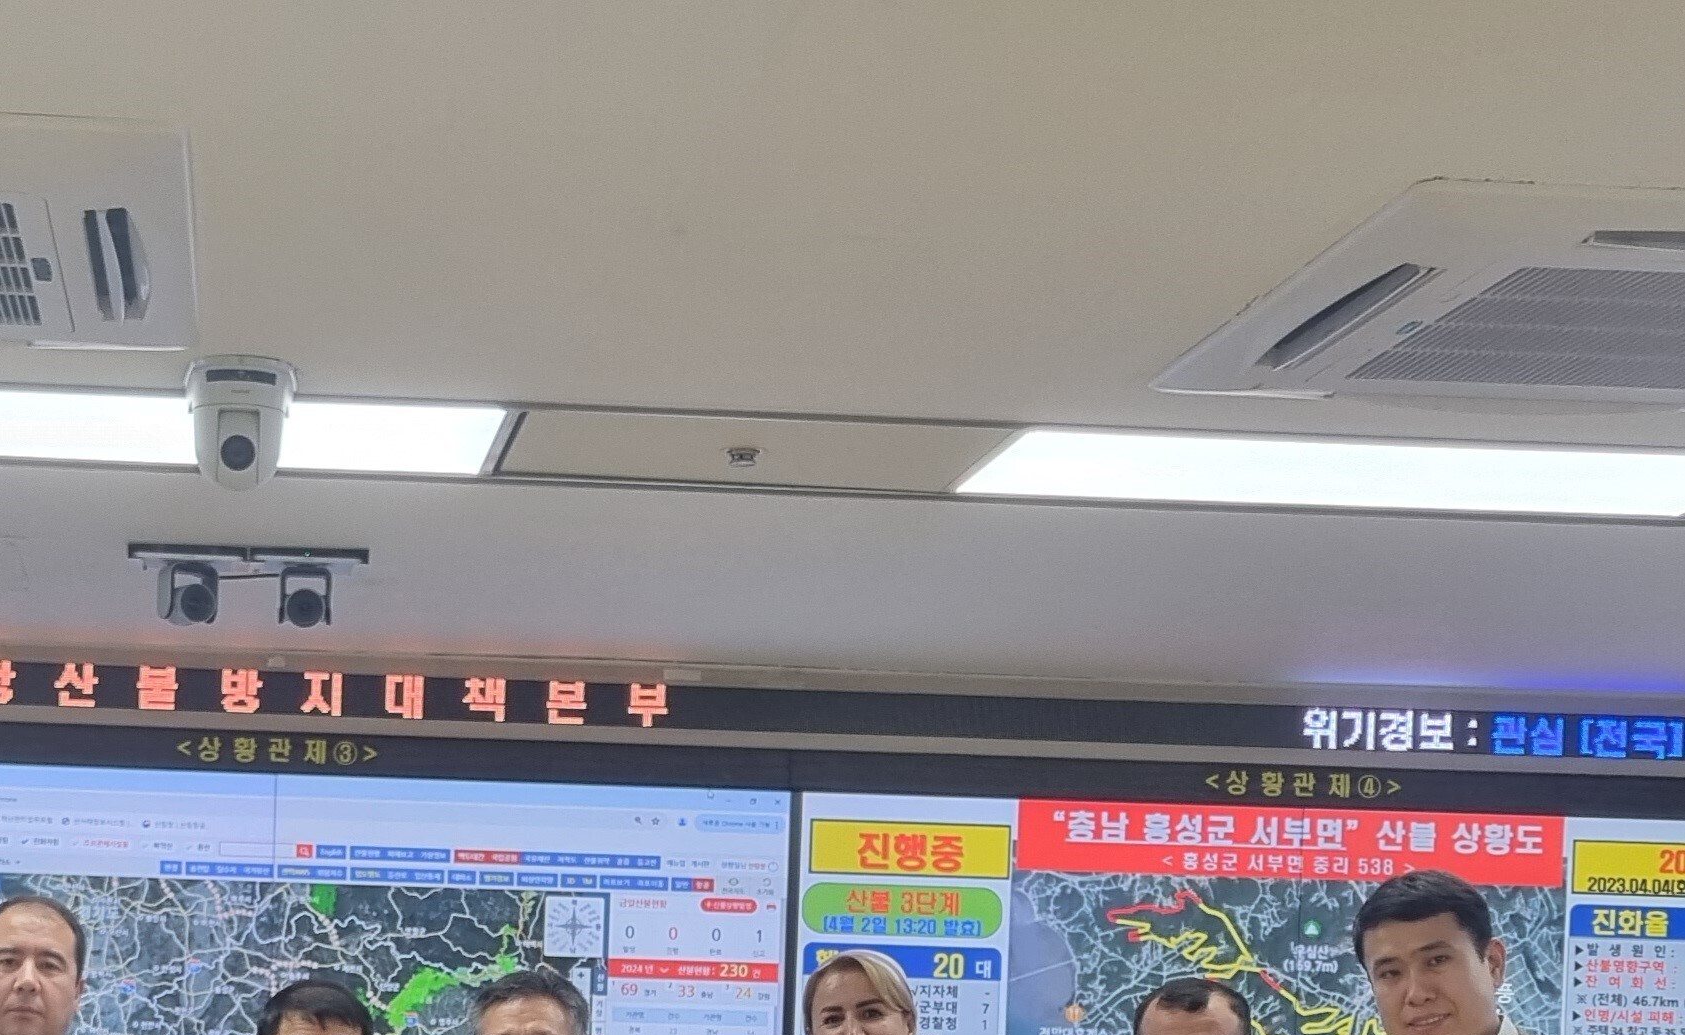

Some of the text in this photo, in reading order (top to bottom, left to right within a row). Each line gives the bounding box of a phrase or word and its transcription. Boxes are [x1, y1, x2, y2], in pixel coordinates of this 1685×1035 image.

[1302, 706, 1454, 752] 위기경보
[1490, 711, 1565, 757] 관심
[1376, 819, 1436, 852] 산불
[1452, 822, 1544, 856] 상황도
[857, 832, 964, 873] 진행중
[1247, 854, 1304, 875] 서부면
[1313, 855, 1350, 876] 중리
[1357, 857, 1394, 876] 538
[846, 888, 960, 916] 산불 3단계
[861, 916, 887, 933] 2일
[895, 918, 937, 935] 13:20
[1592, 908, 1669, 938] 진화율
[625, 925, 635, 939] 0
[668, 926, 678, 940] 0
[711, 928, 721, 942] 0
[719, 964, 748, 977] 230
[933, 952, 992, 979] 20 대
[621, 983, 638, 996] 69
[678, 984, 695, 998] 33
[735, 986, 752, 999] 24
[918, 1000, 990, 1015] 군부대 7
[918, 1016, 957, 1031] 경찰청
[1648, 1011, 1675, 1025] 피해
